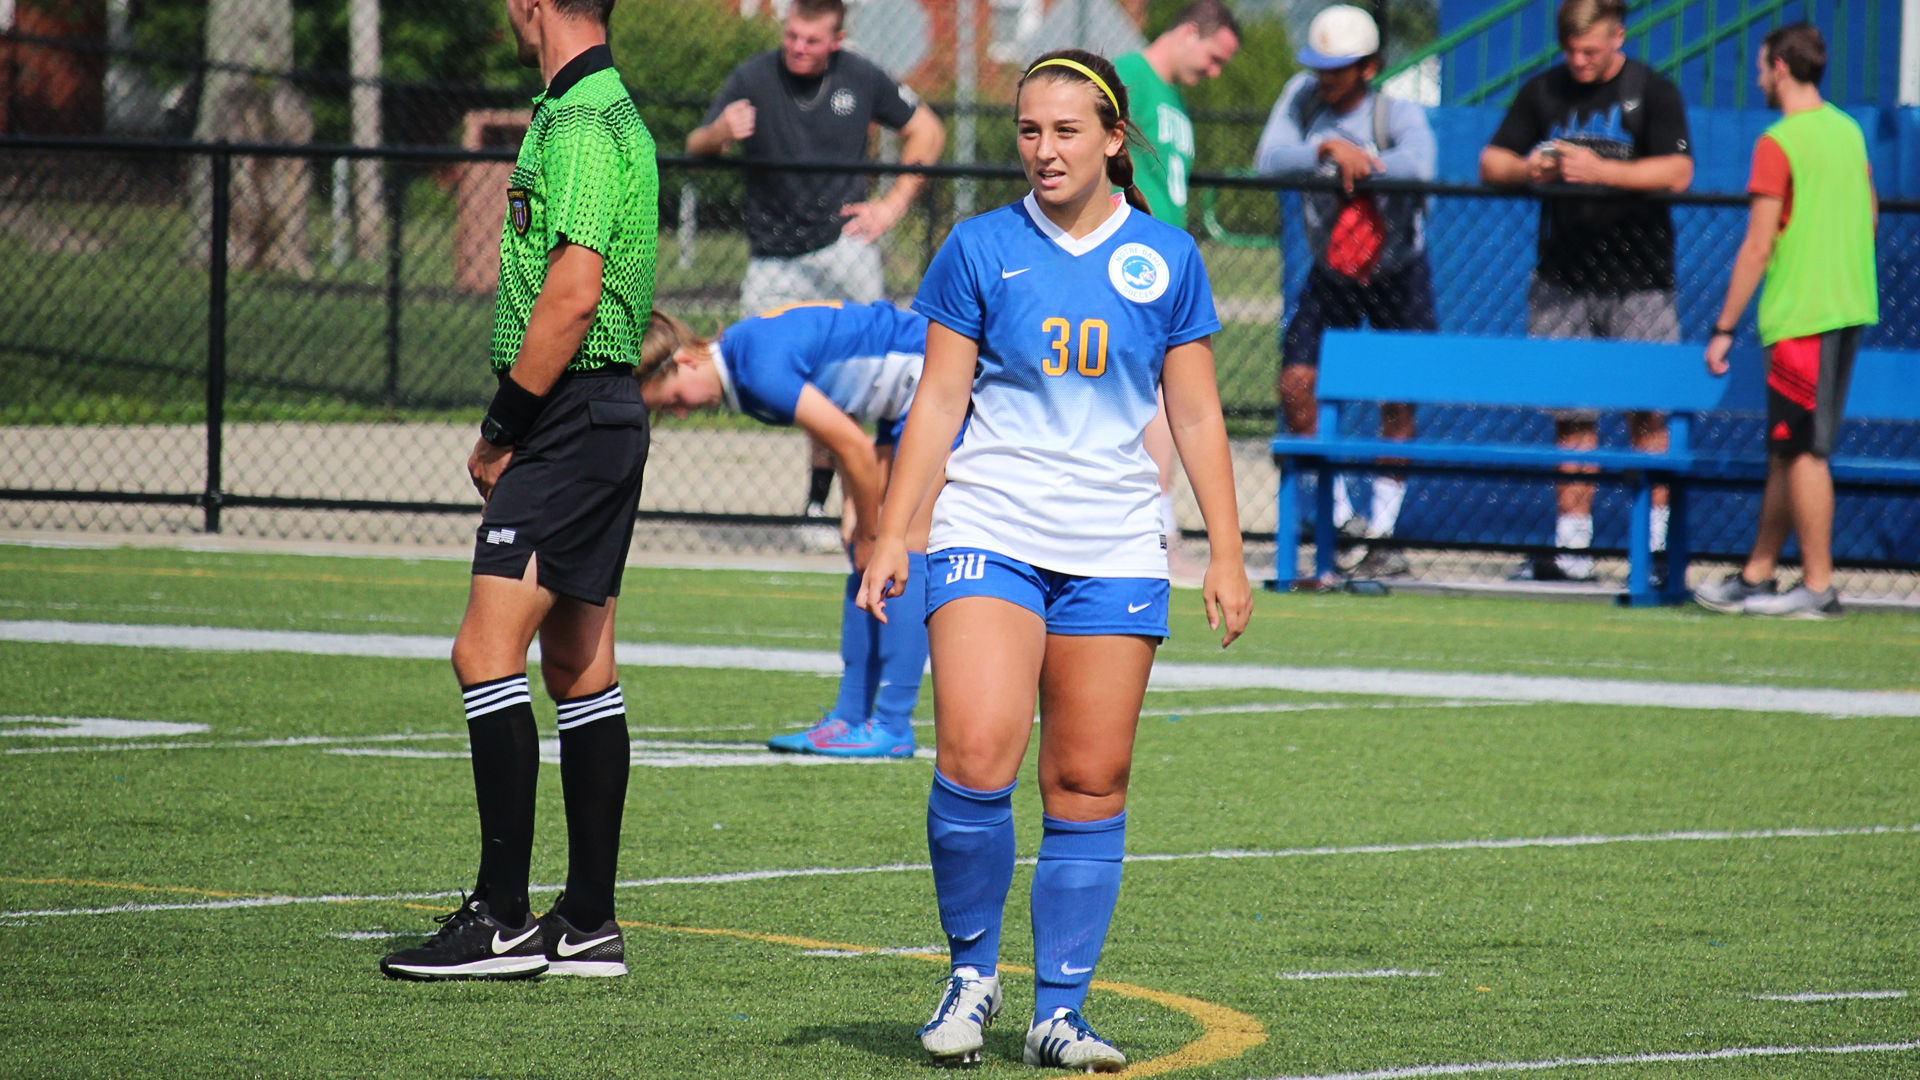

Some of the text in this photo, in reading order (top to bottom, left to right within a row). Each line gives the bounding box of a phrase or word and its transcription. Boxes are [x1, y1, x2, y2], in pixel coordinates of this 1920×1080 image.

[1115, 247, 1163, 269] NOTRE DAME
[1123, 285, 1156, 299] SOCCER
[1041, 317, 1109, 377] 30
[945, 553, 987, 585] 30
